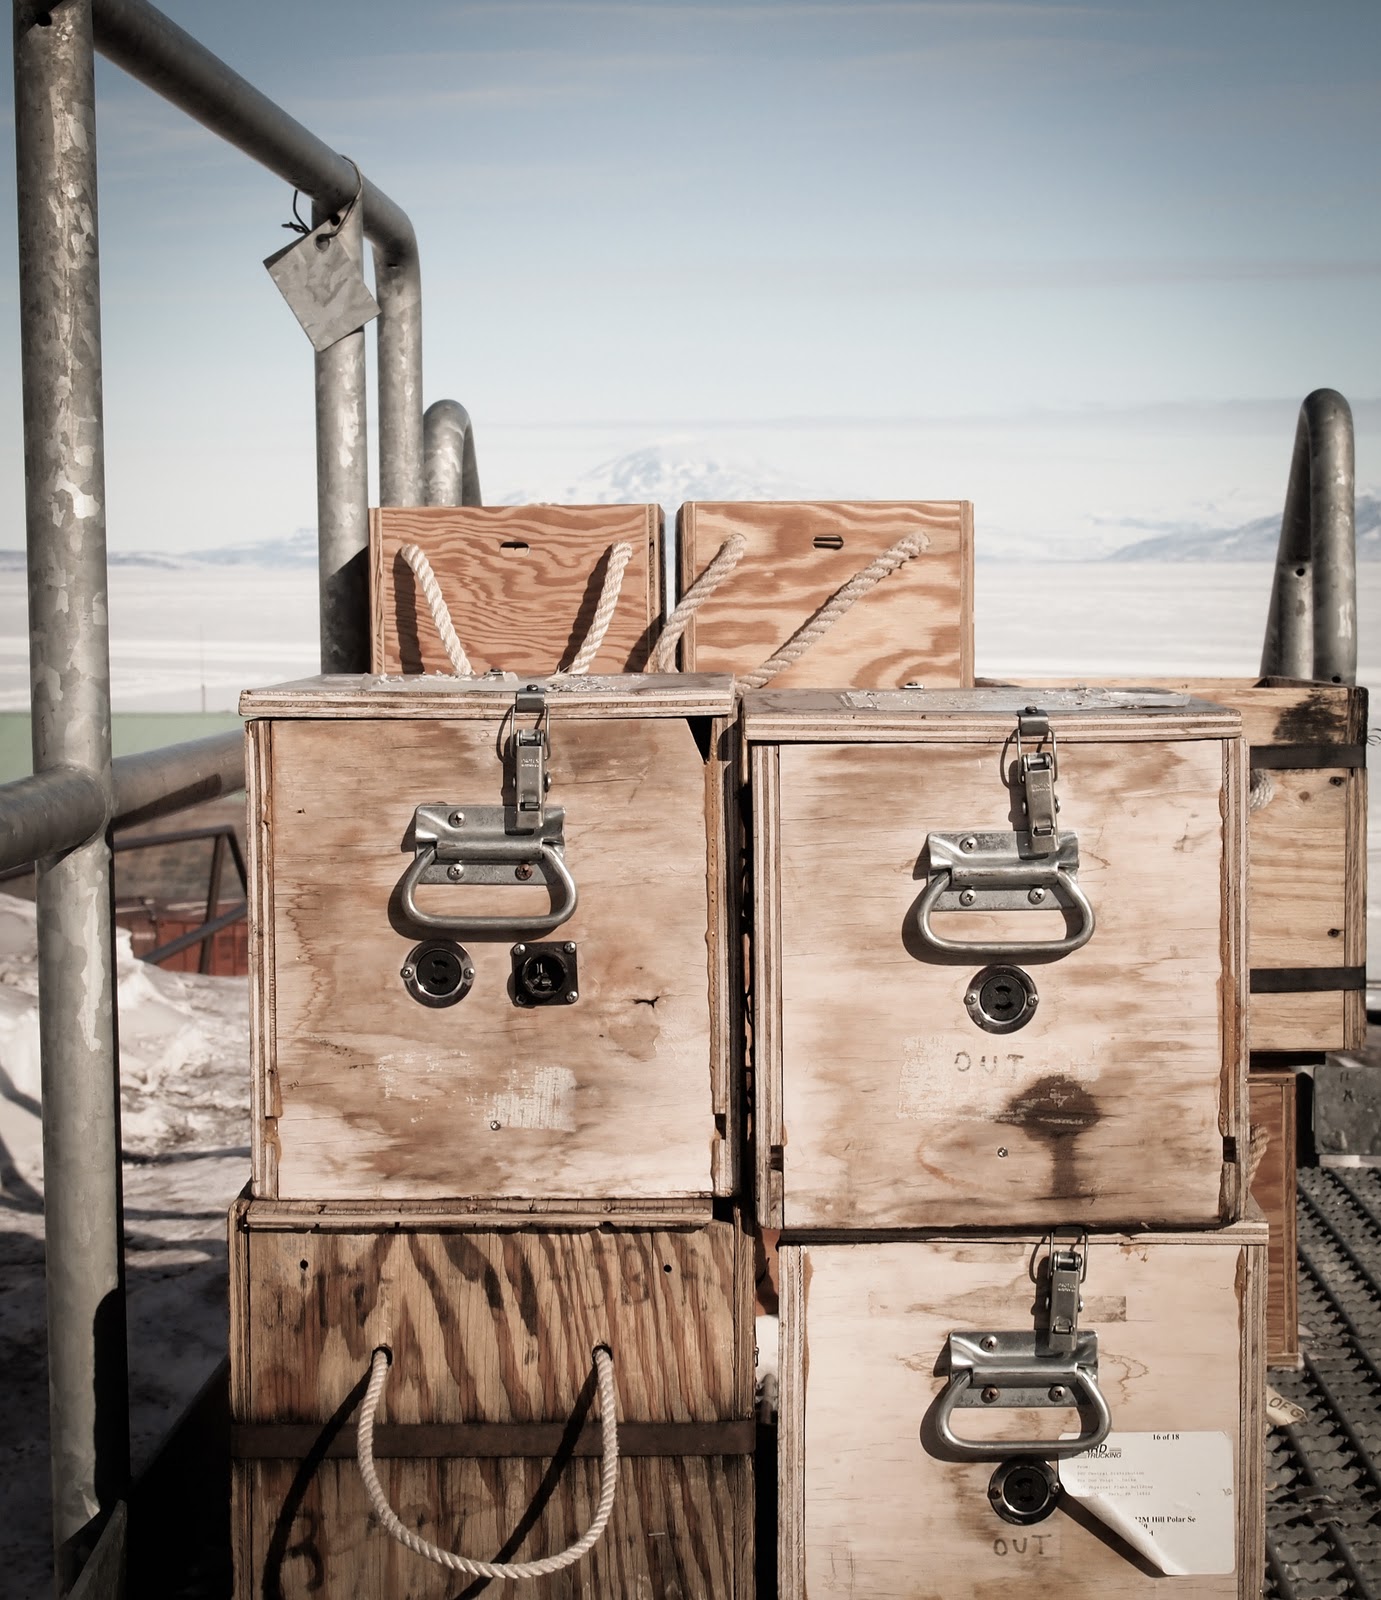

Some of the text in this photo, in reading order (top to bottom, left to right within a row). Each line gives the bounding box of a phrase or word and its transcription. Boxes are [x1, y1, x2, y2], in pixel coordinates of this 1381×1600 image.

[954, 1050, 1025, 1079] OUT
[1152, 1433, 1180, 1441] 16 of 18
[1087, 1451, 1122, 1459] TRUCKING
[992, 1533, 1053, 1557] OUT
